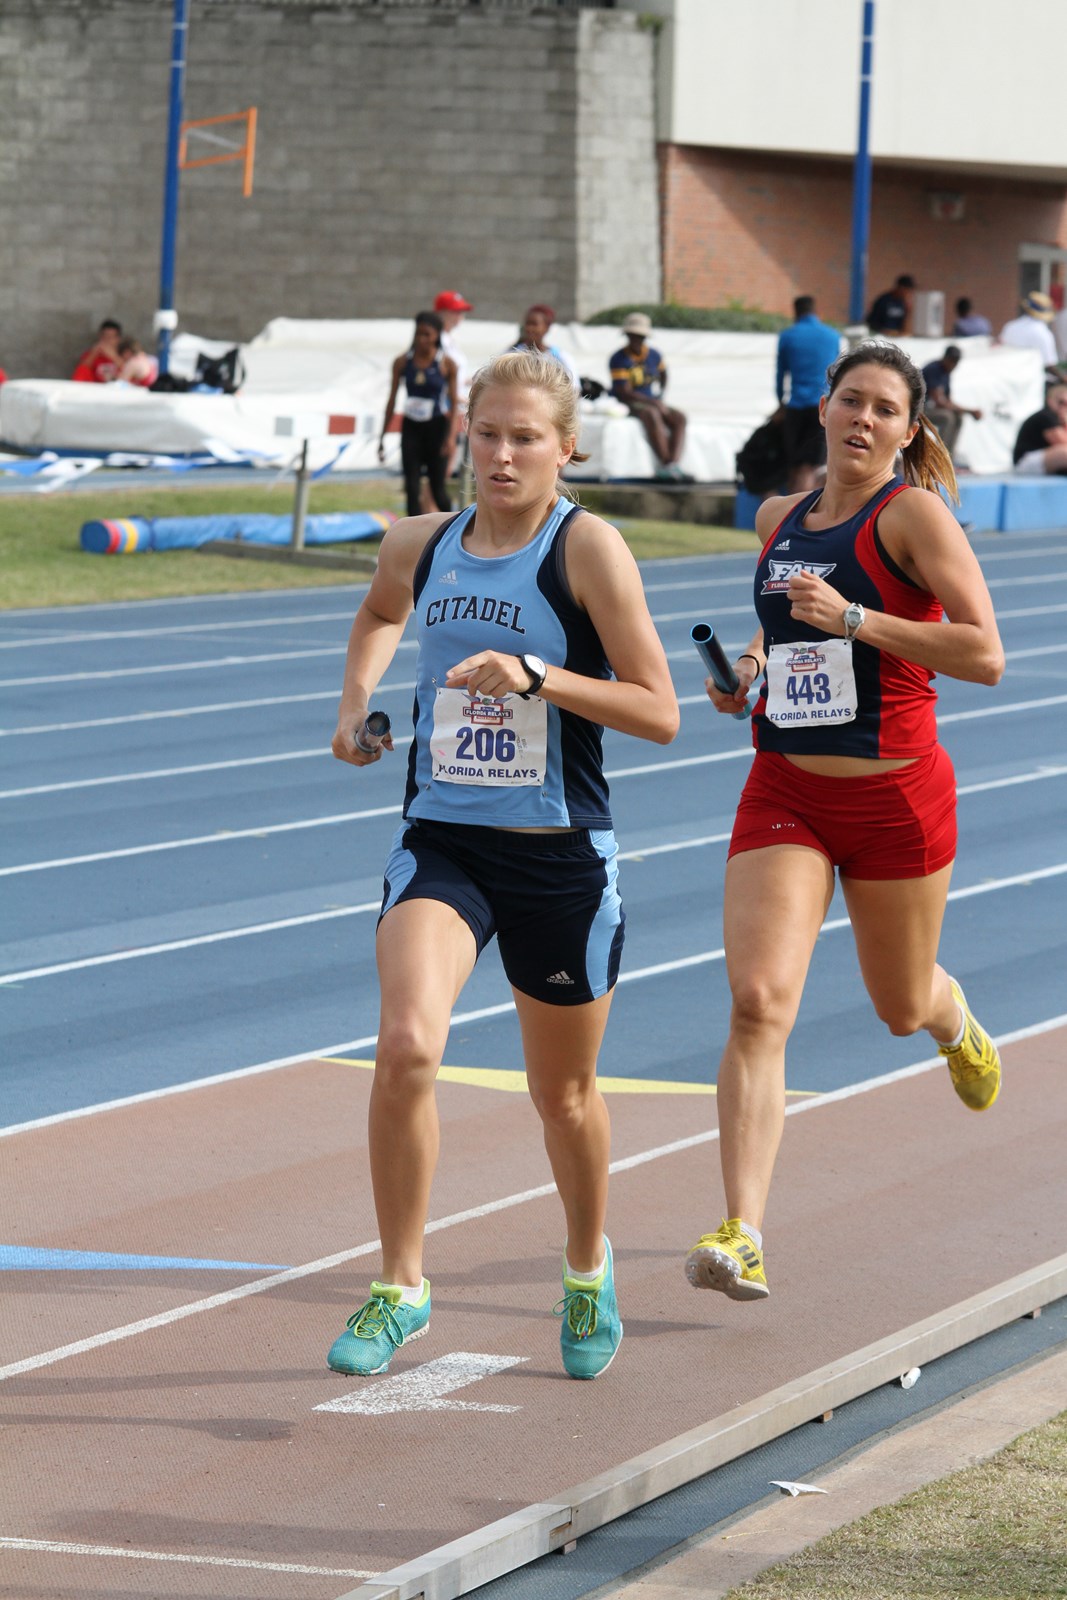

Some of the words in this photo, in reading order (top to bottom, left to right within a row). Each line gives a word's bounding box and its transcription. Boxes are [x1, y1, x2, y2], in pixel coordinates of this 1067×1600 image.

[769, 562, 832, 582] FAU
[425, 595, 526, 635] CITADEL
[786, 673, 831, 706] 443
[770, 711, 808, 721] FLORIDA
[811, 708, 851, 719] RELAYS
[455, 726, 516, 763] 206
[488, 768, 538, 778] RELAYS
